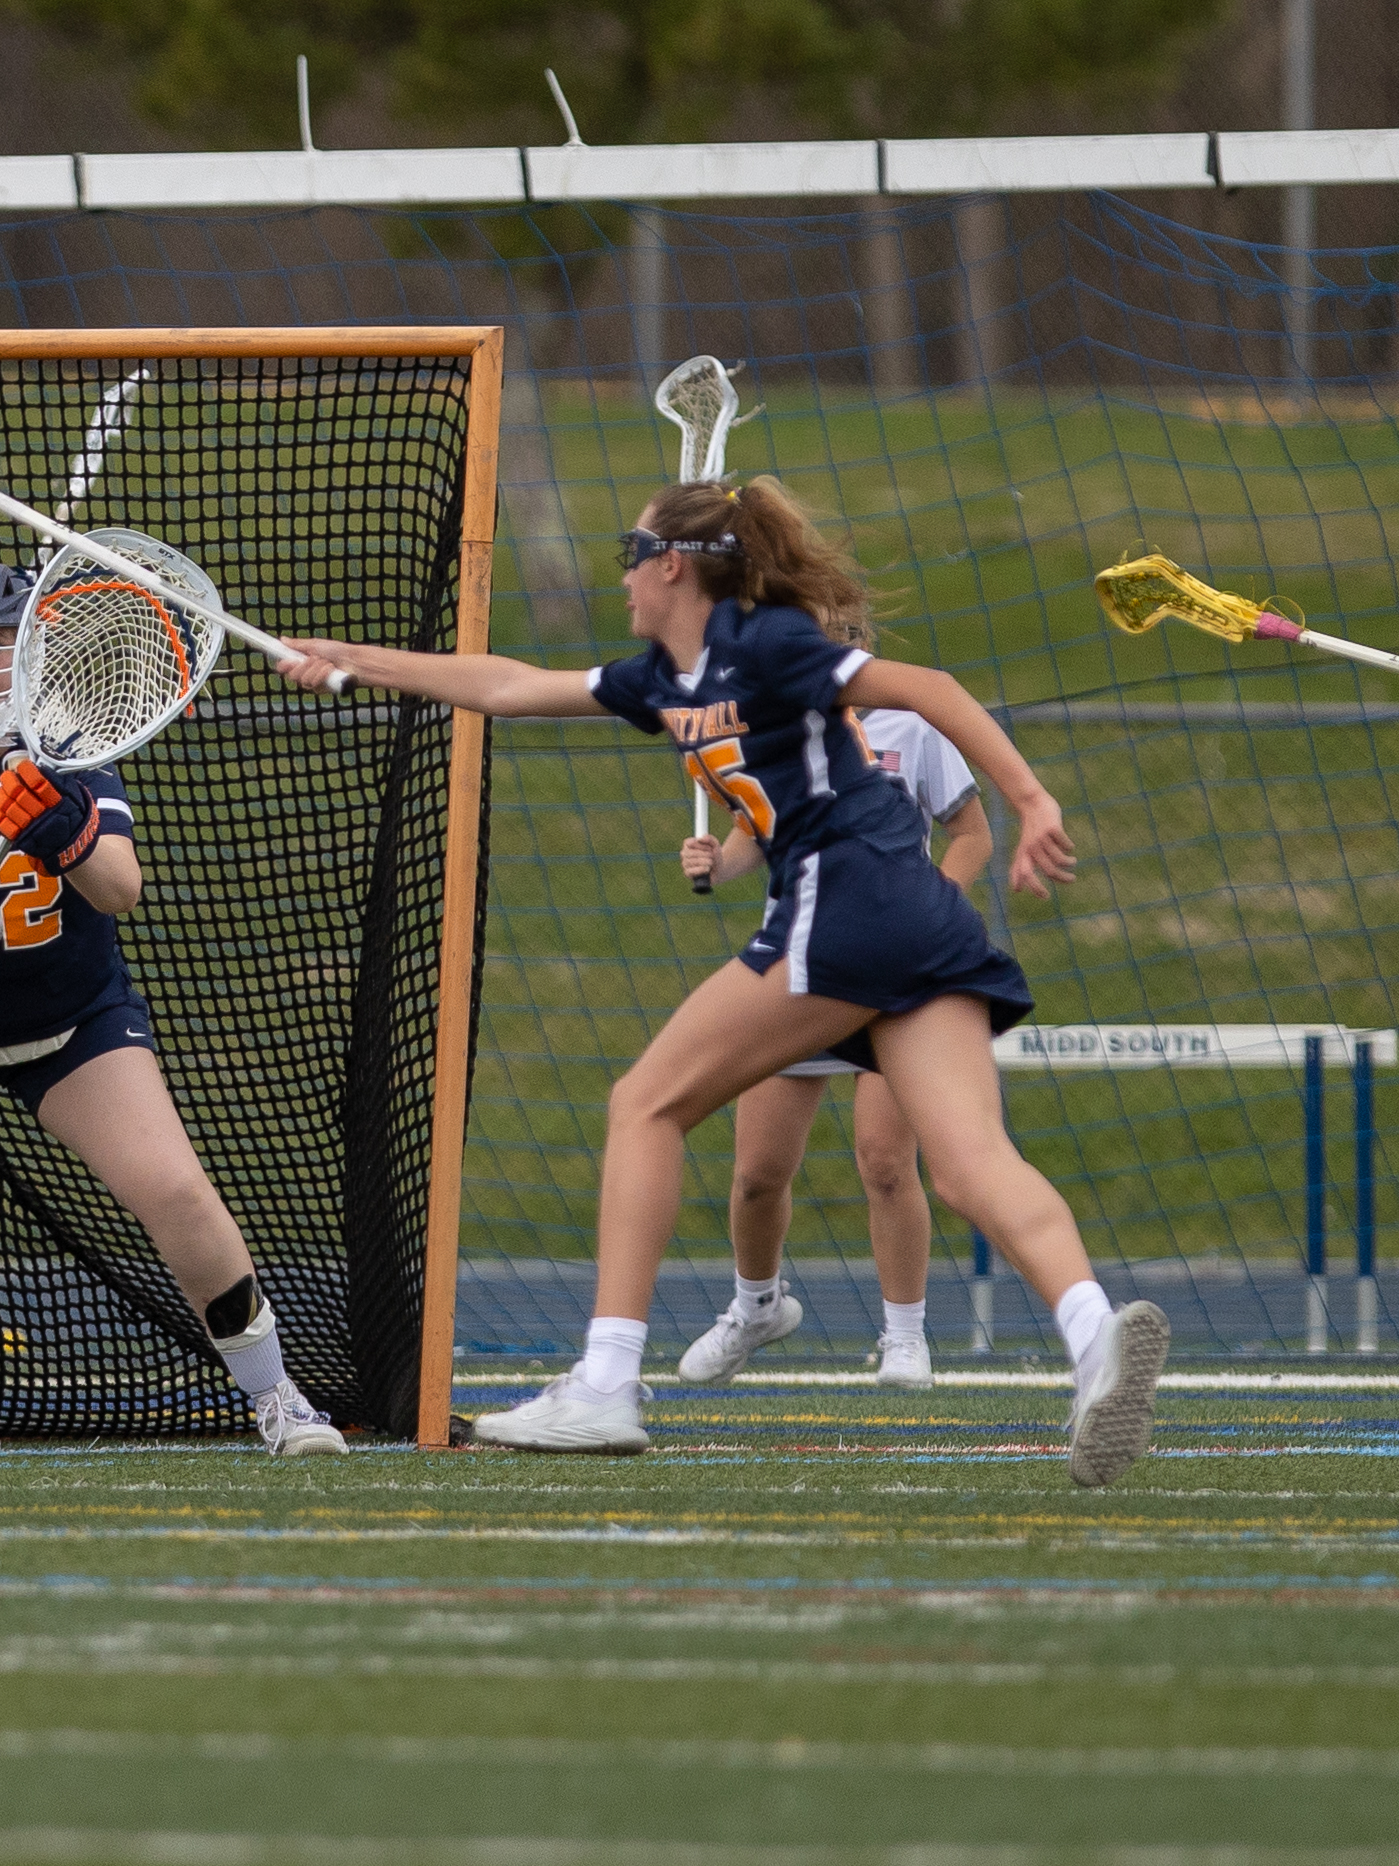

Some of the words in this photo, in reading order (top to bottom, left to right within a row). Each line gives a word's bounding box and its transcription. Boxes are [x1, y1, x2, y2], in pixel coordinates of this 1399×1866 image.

[673, 541, 704, 550] GAIT
[1020, 1031, 1098, 1054] MIDD
[1108, 1031, 1209, 1054] SOUTH
